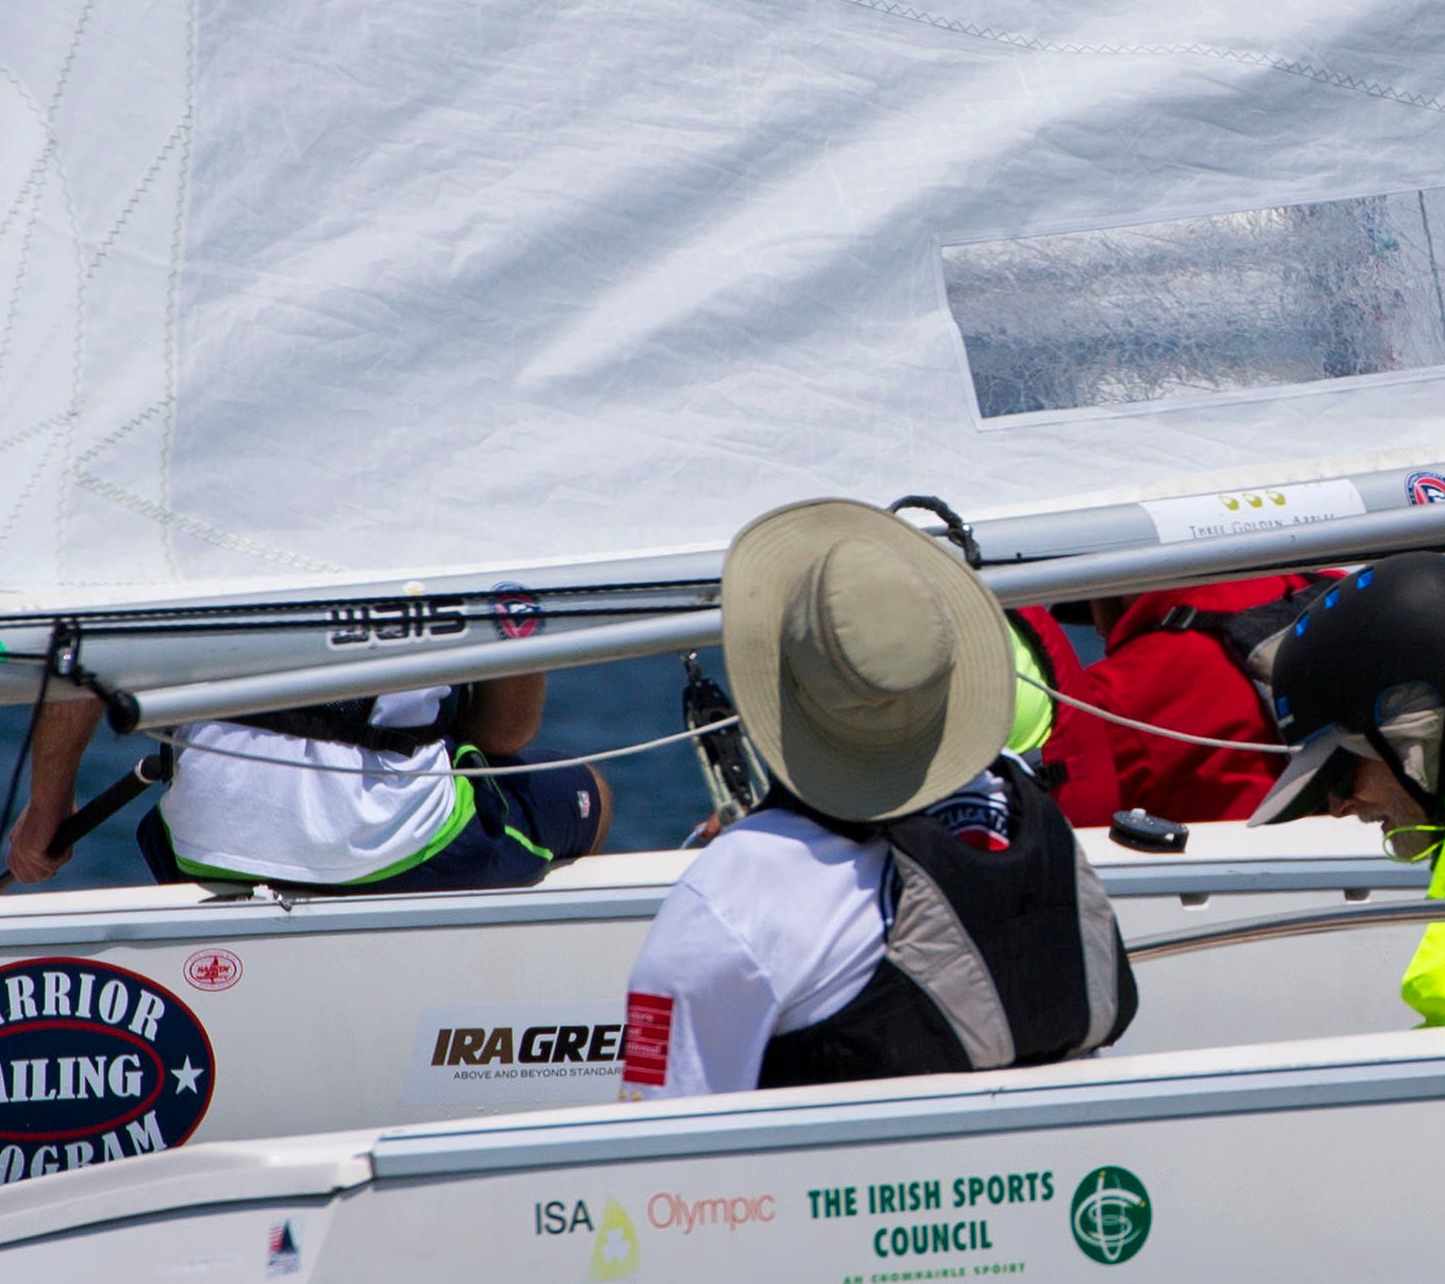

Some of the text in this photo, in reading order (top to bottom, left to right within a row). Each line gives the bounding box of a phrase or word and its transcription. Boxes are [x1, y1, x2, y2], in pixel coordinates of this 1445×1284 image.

[431, 1027, 513, 1066] IRA
[453, 1070, 492, 1080] ABOVE
[493, 1069, 518, 1079] AND
[520, 1068, 568, 1079] BEYOND
[647, 1192, 777, 1235] Olympic
[808, 1171, 1054, 1218] THE IRISH SPORTS
[535, 1199, 595, 1236] ISA
[874, 1219, 993, 1258] COUNCIL
